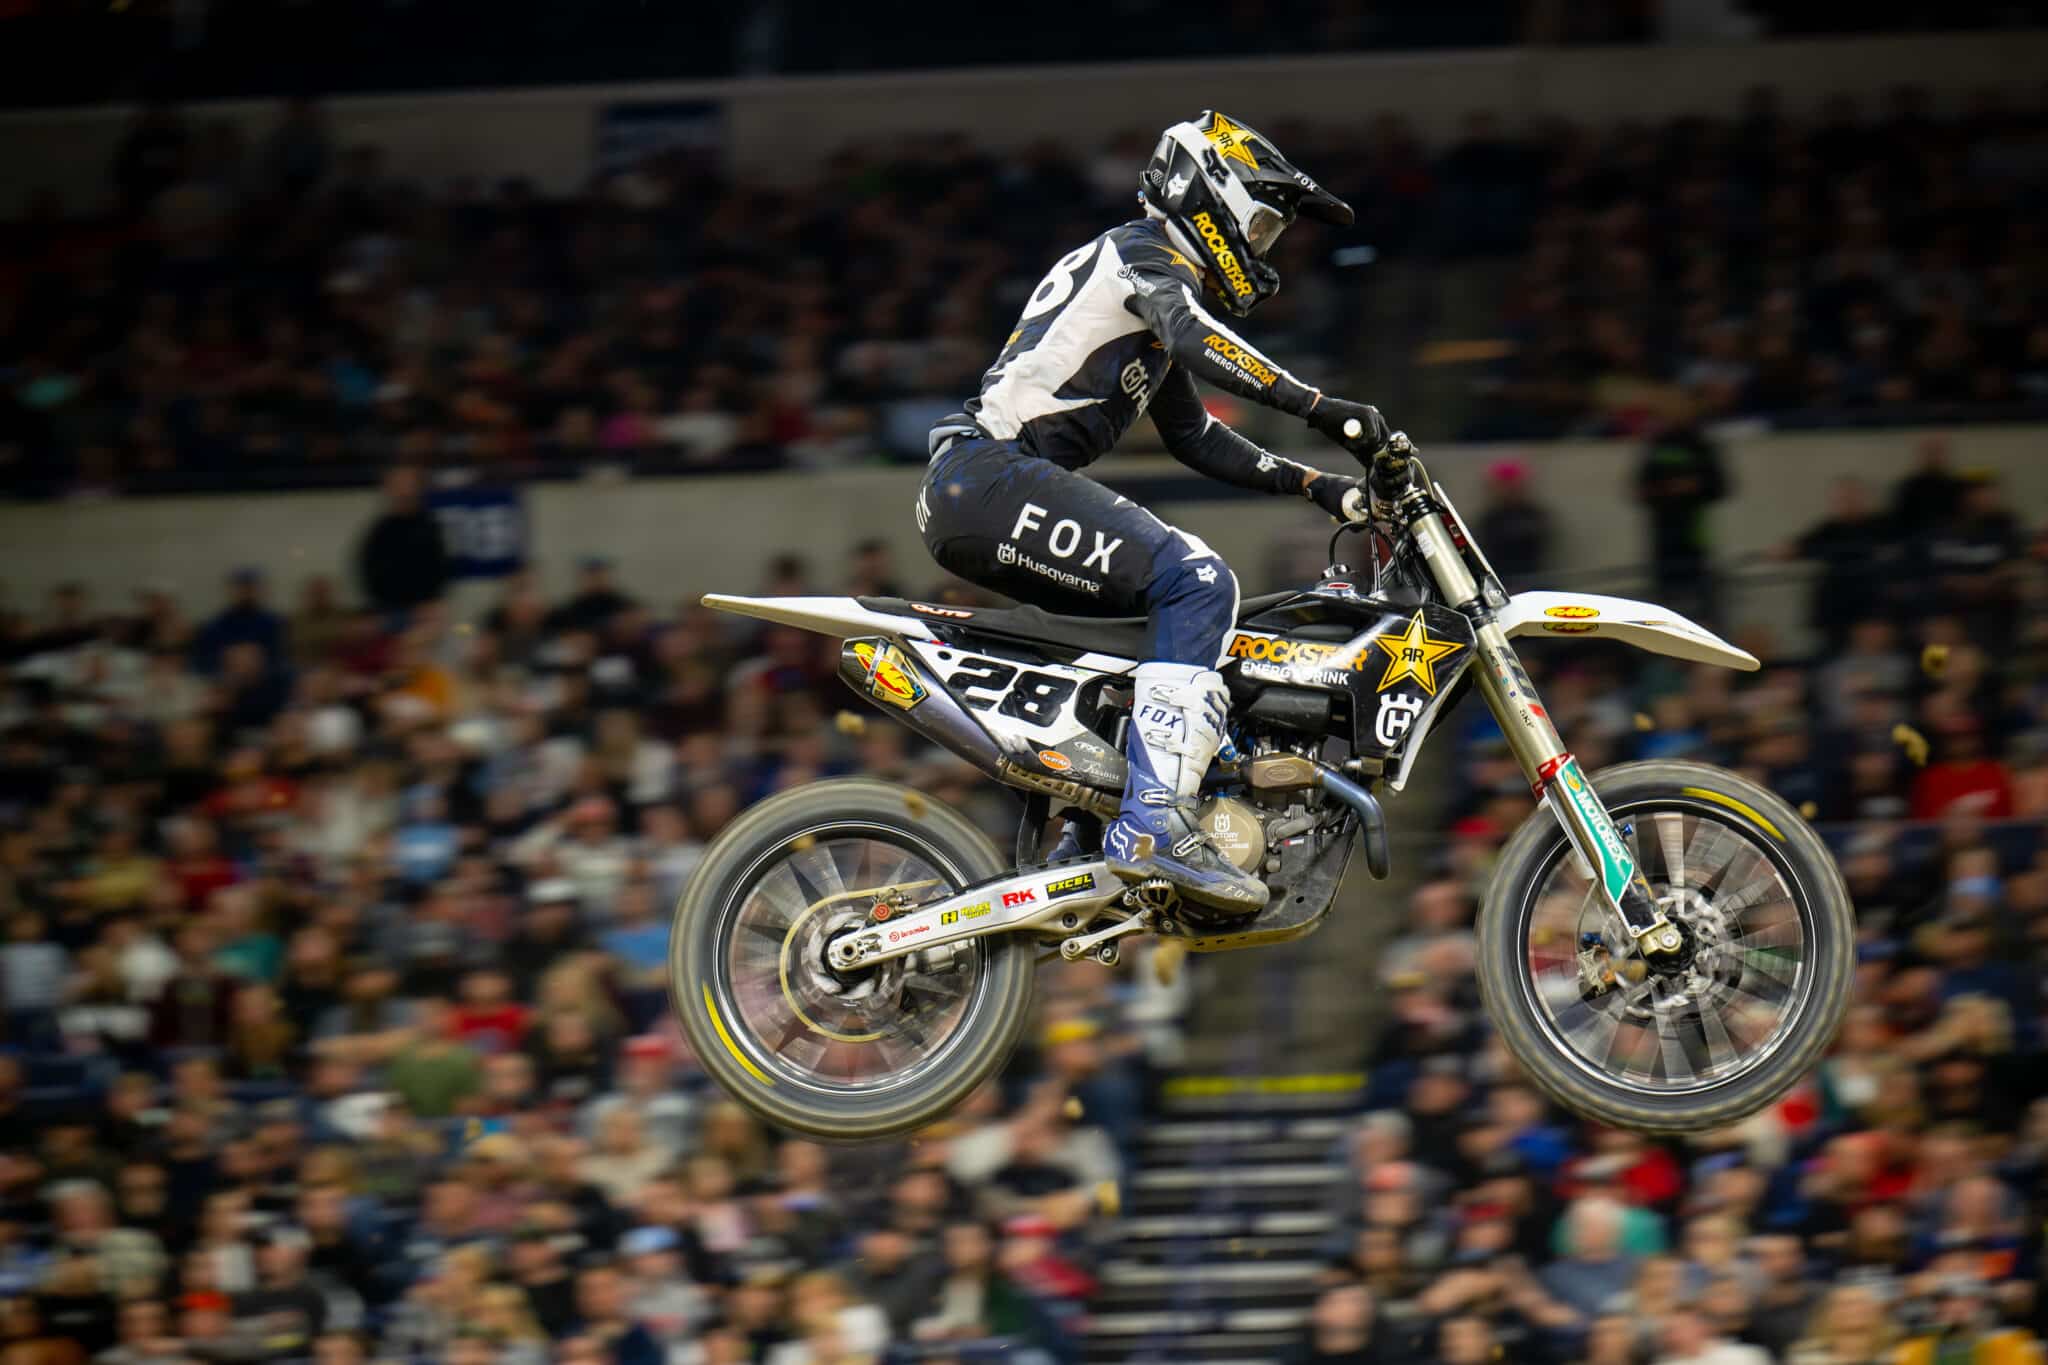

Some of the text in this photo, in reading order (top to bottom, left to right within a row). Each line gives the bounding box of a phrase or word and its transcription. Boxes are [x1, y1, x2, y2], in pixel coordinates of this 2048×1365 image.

[1293, 171, 1318, 191] FOX
[1193, 211, 1254, 298] ROCKSTAR
[1203, 333, 1277, 387] ROCKSTAR
[1204, 348, 1263, 391] ENERGY DRINK
[1010, 503, 1124, 574] FOX
[1018, 552, 1100, 592] Husqvarna
[1226, 633, 1368, 672] ROCKSTR
[1240, 661, 1306, 683] ENERG
[948, 657, 1078, 728] 28
[1139, 704, 1183, 729] FOX
[1574, 790, 1633, 865] MOTOREX
[1002, 888, 1036, 908] RK
[1047, 876, 1093, 893] EXCEL
